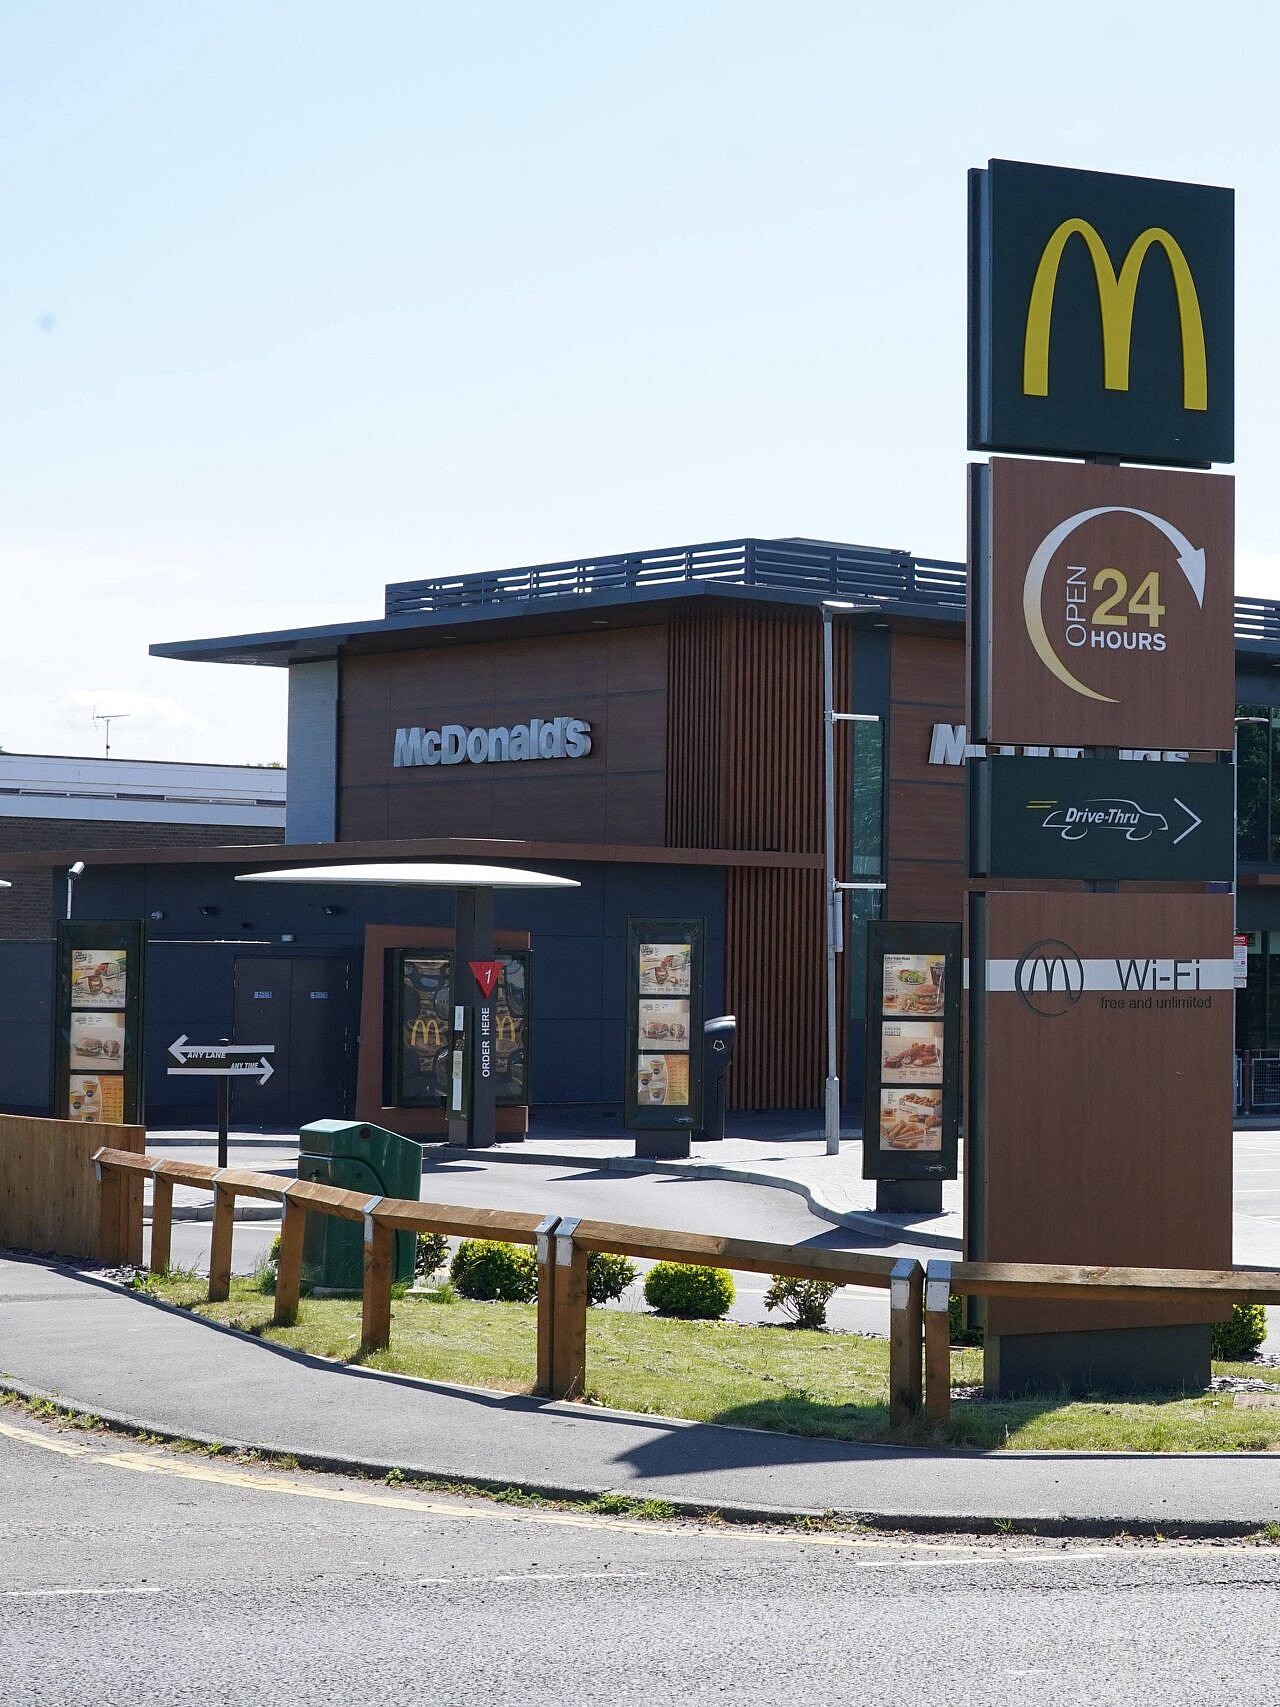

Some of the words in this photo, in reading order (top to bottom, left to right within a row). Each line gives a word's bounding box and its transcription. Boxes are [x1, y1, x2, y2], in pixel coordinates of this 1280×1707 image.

[1066, 566, 1087, 647] OPEN
[1092, 568, 1166, 628] 24
[1091, 630, 1168, 651] HOURS
[394, 717, 592, 767] McDonald's
[1065, 807, 1140, 825] Drive-Thru
[484, 969, 492, 984] 1
[1116, 960, 1200, 991] Wi-Fi
[1101, 997, 1125, 1009] free
[1129, 997, 1152, 1009] and
[1156, 997, 1212, 1009] unlimited
[482, 1007, 490, 1035] HERE
[482, 1040, 490, 1078] ORDER
